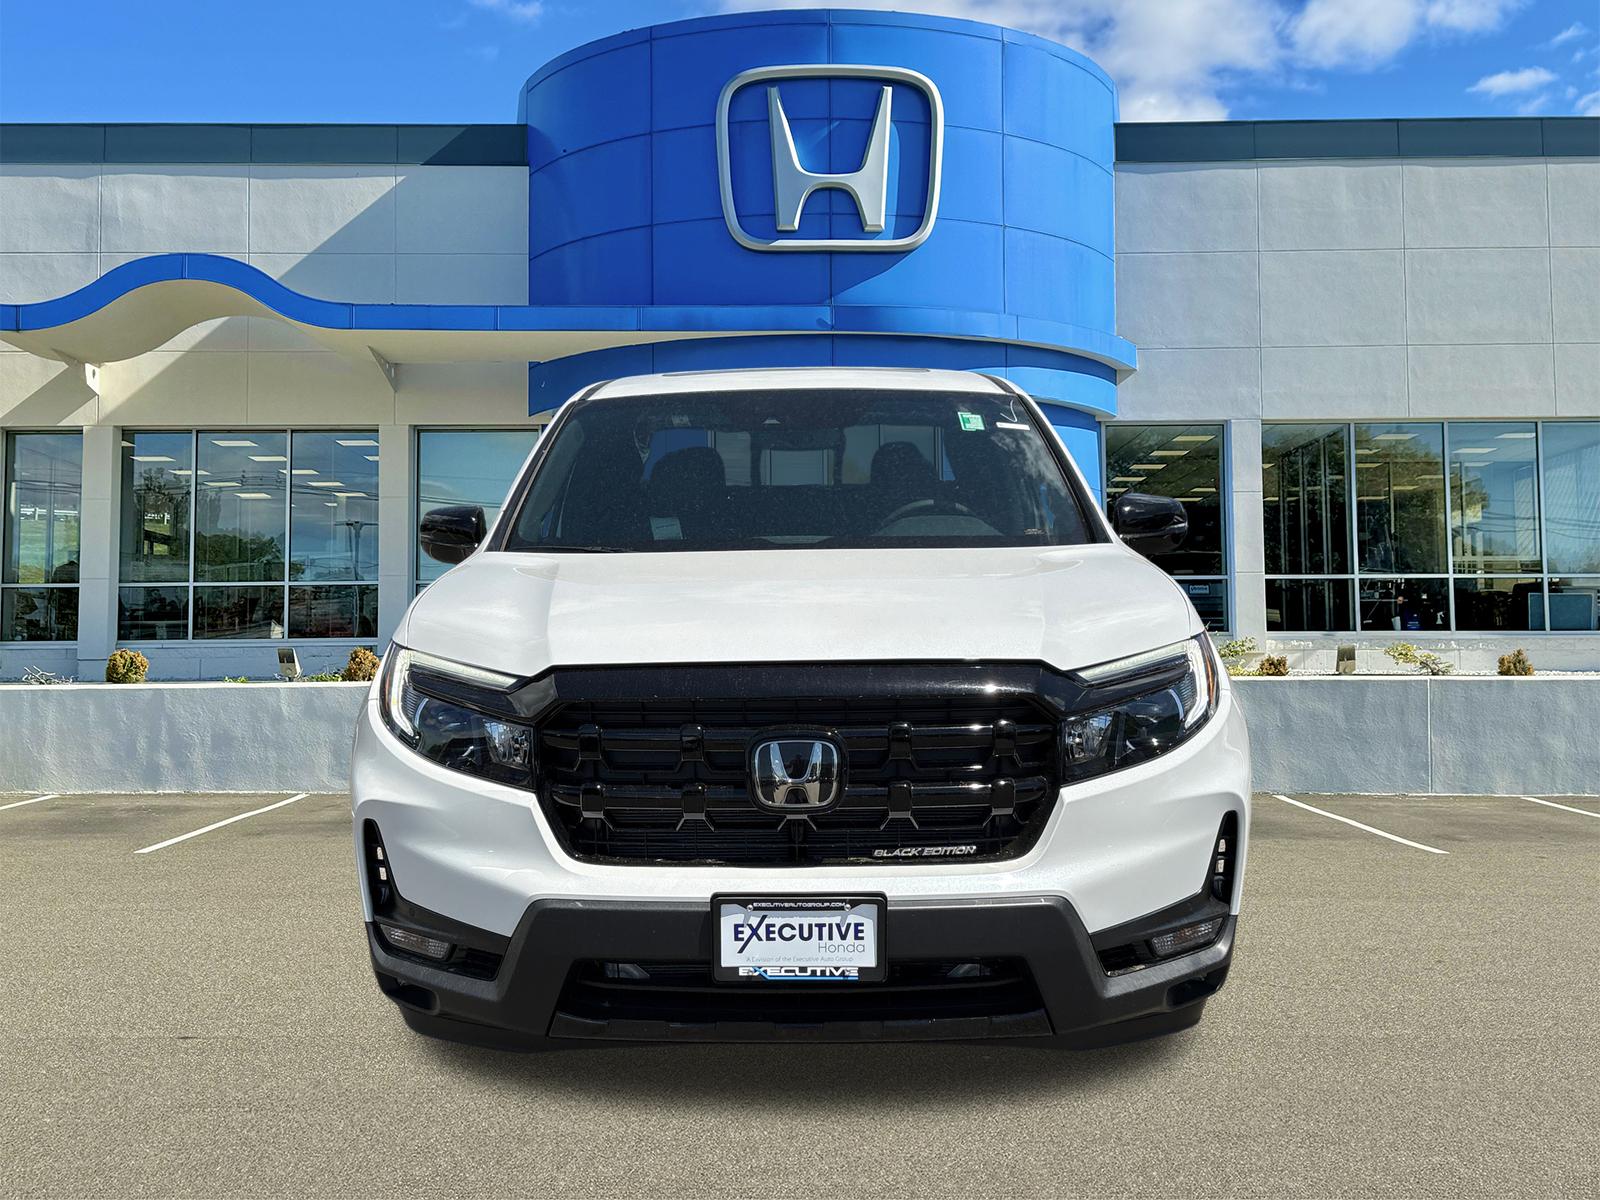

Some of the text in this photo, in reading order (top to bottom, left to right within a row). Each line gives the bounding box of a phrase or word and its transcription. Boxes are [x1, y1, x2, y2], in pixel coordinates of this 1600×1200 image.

[874, 845, 977, 857] BLACK EDITION
[733, 914, 865, 954] EXECUTIVE
[818, 942, 865, 953] Honda
[738, 967, 859, 976] EXECUTIVE
